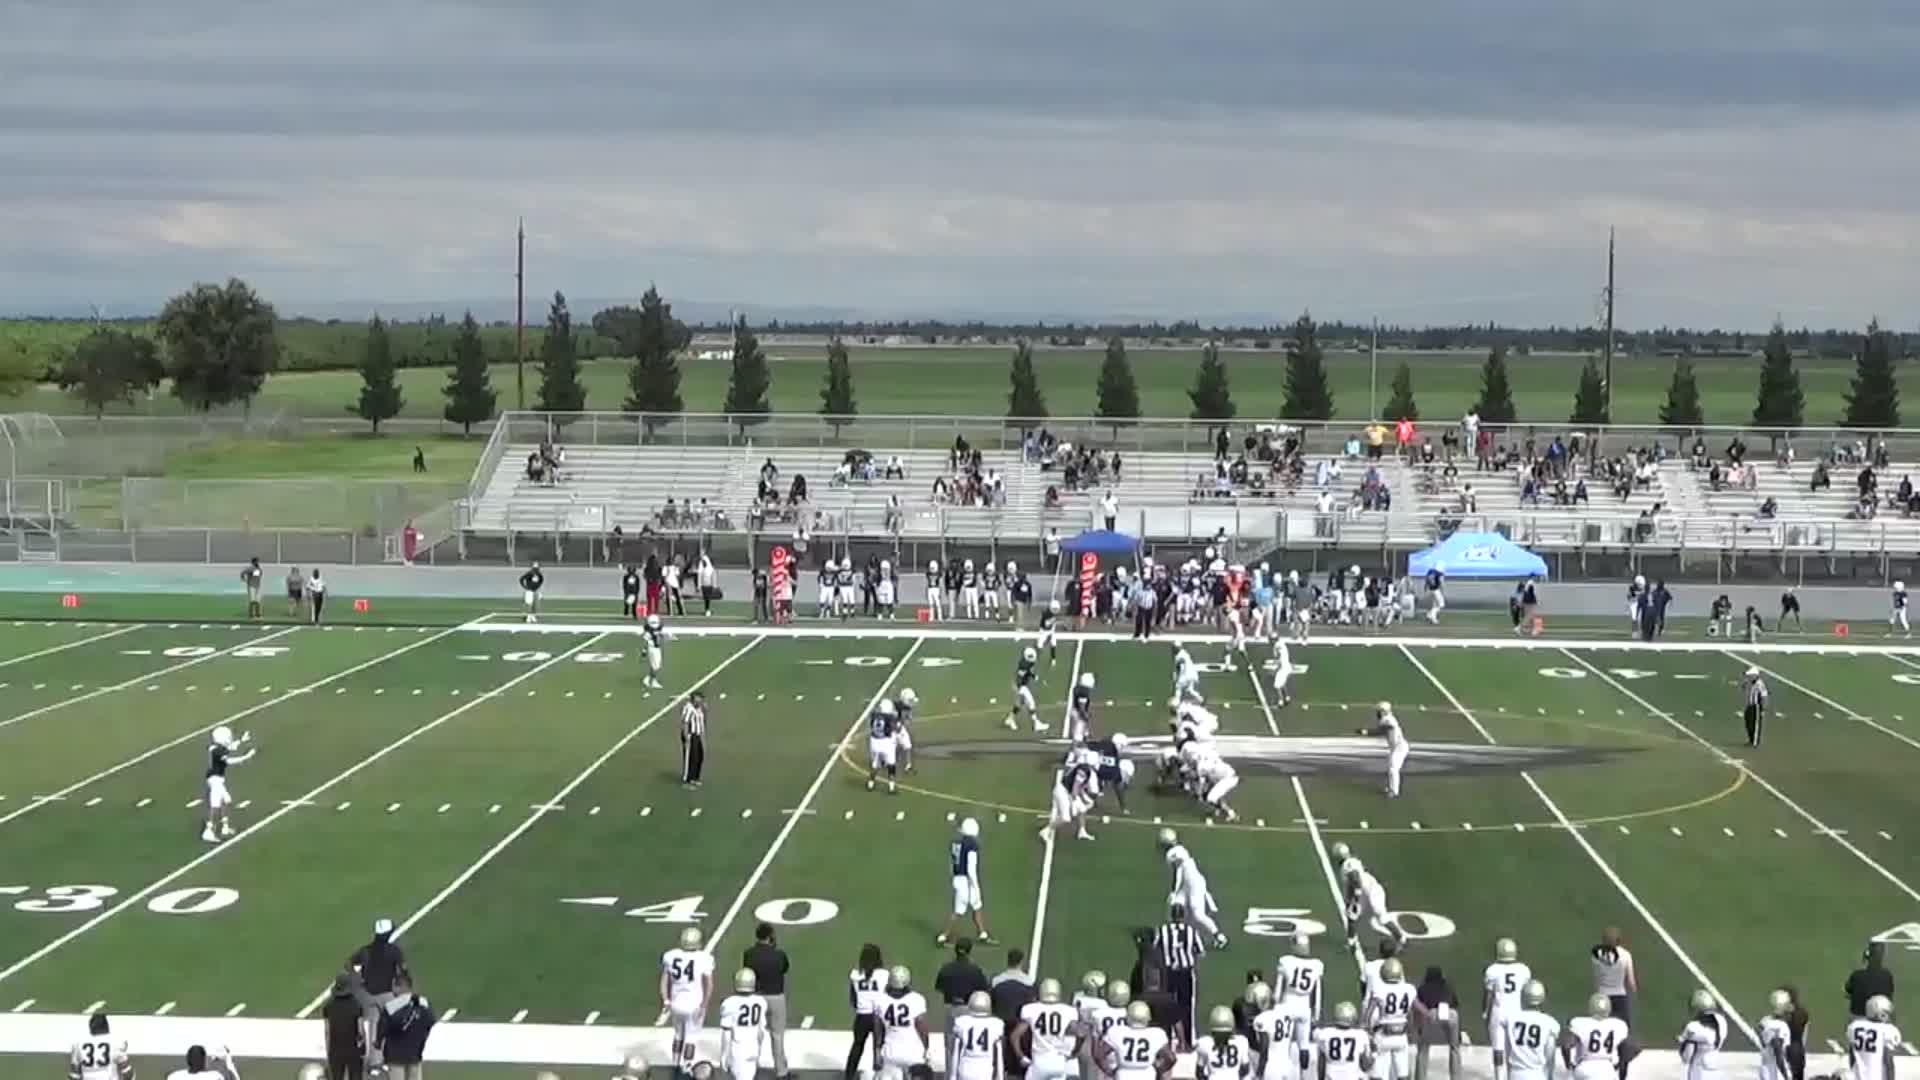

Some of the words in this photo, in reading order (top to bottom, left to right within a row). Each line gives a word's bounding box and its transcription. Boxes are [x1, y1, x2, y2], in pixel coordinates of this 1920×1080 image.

[670, 957, 695, 982] 54
[1289, 966, 1313, 991] 15
[1503, 973, 1517, 994] 5
[737, 1003, 762, 1027] 20
[884, 1003, 911, 1027] 42
[1384, 991, 1409, 1015] 84
[1034, 1011, 1062, 1036] 40
[1512, 1022, 1542, 1048] 79
[966, 1027, 989, 1052] 14
[1122, 1036, 1150, 1062] 72
[1328, 1037, 1357, 1062] 87
[1588, 1029, 1615, 1054] 64
[1853, 1027, 1878, 1052] 52
[81, 1042, 112, 1068] 33
[1211, 1044, 1239, 1068] 38
